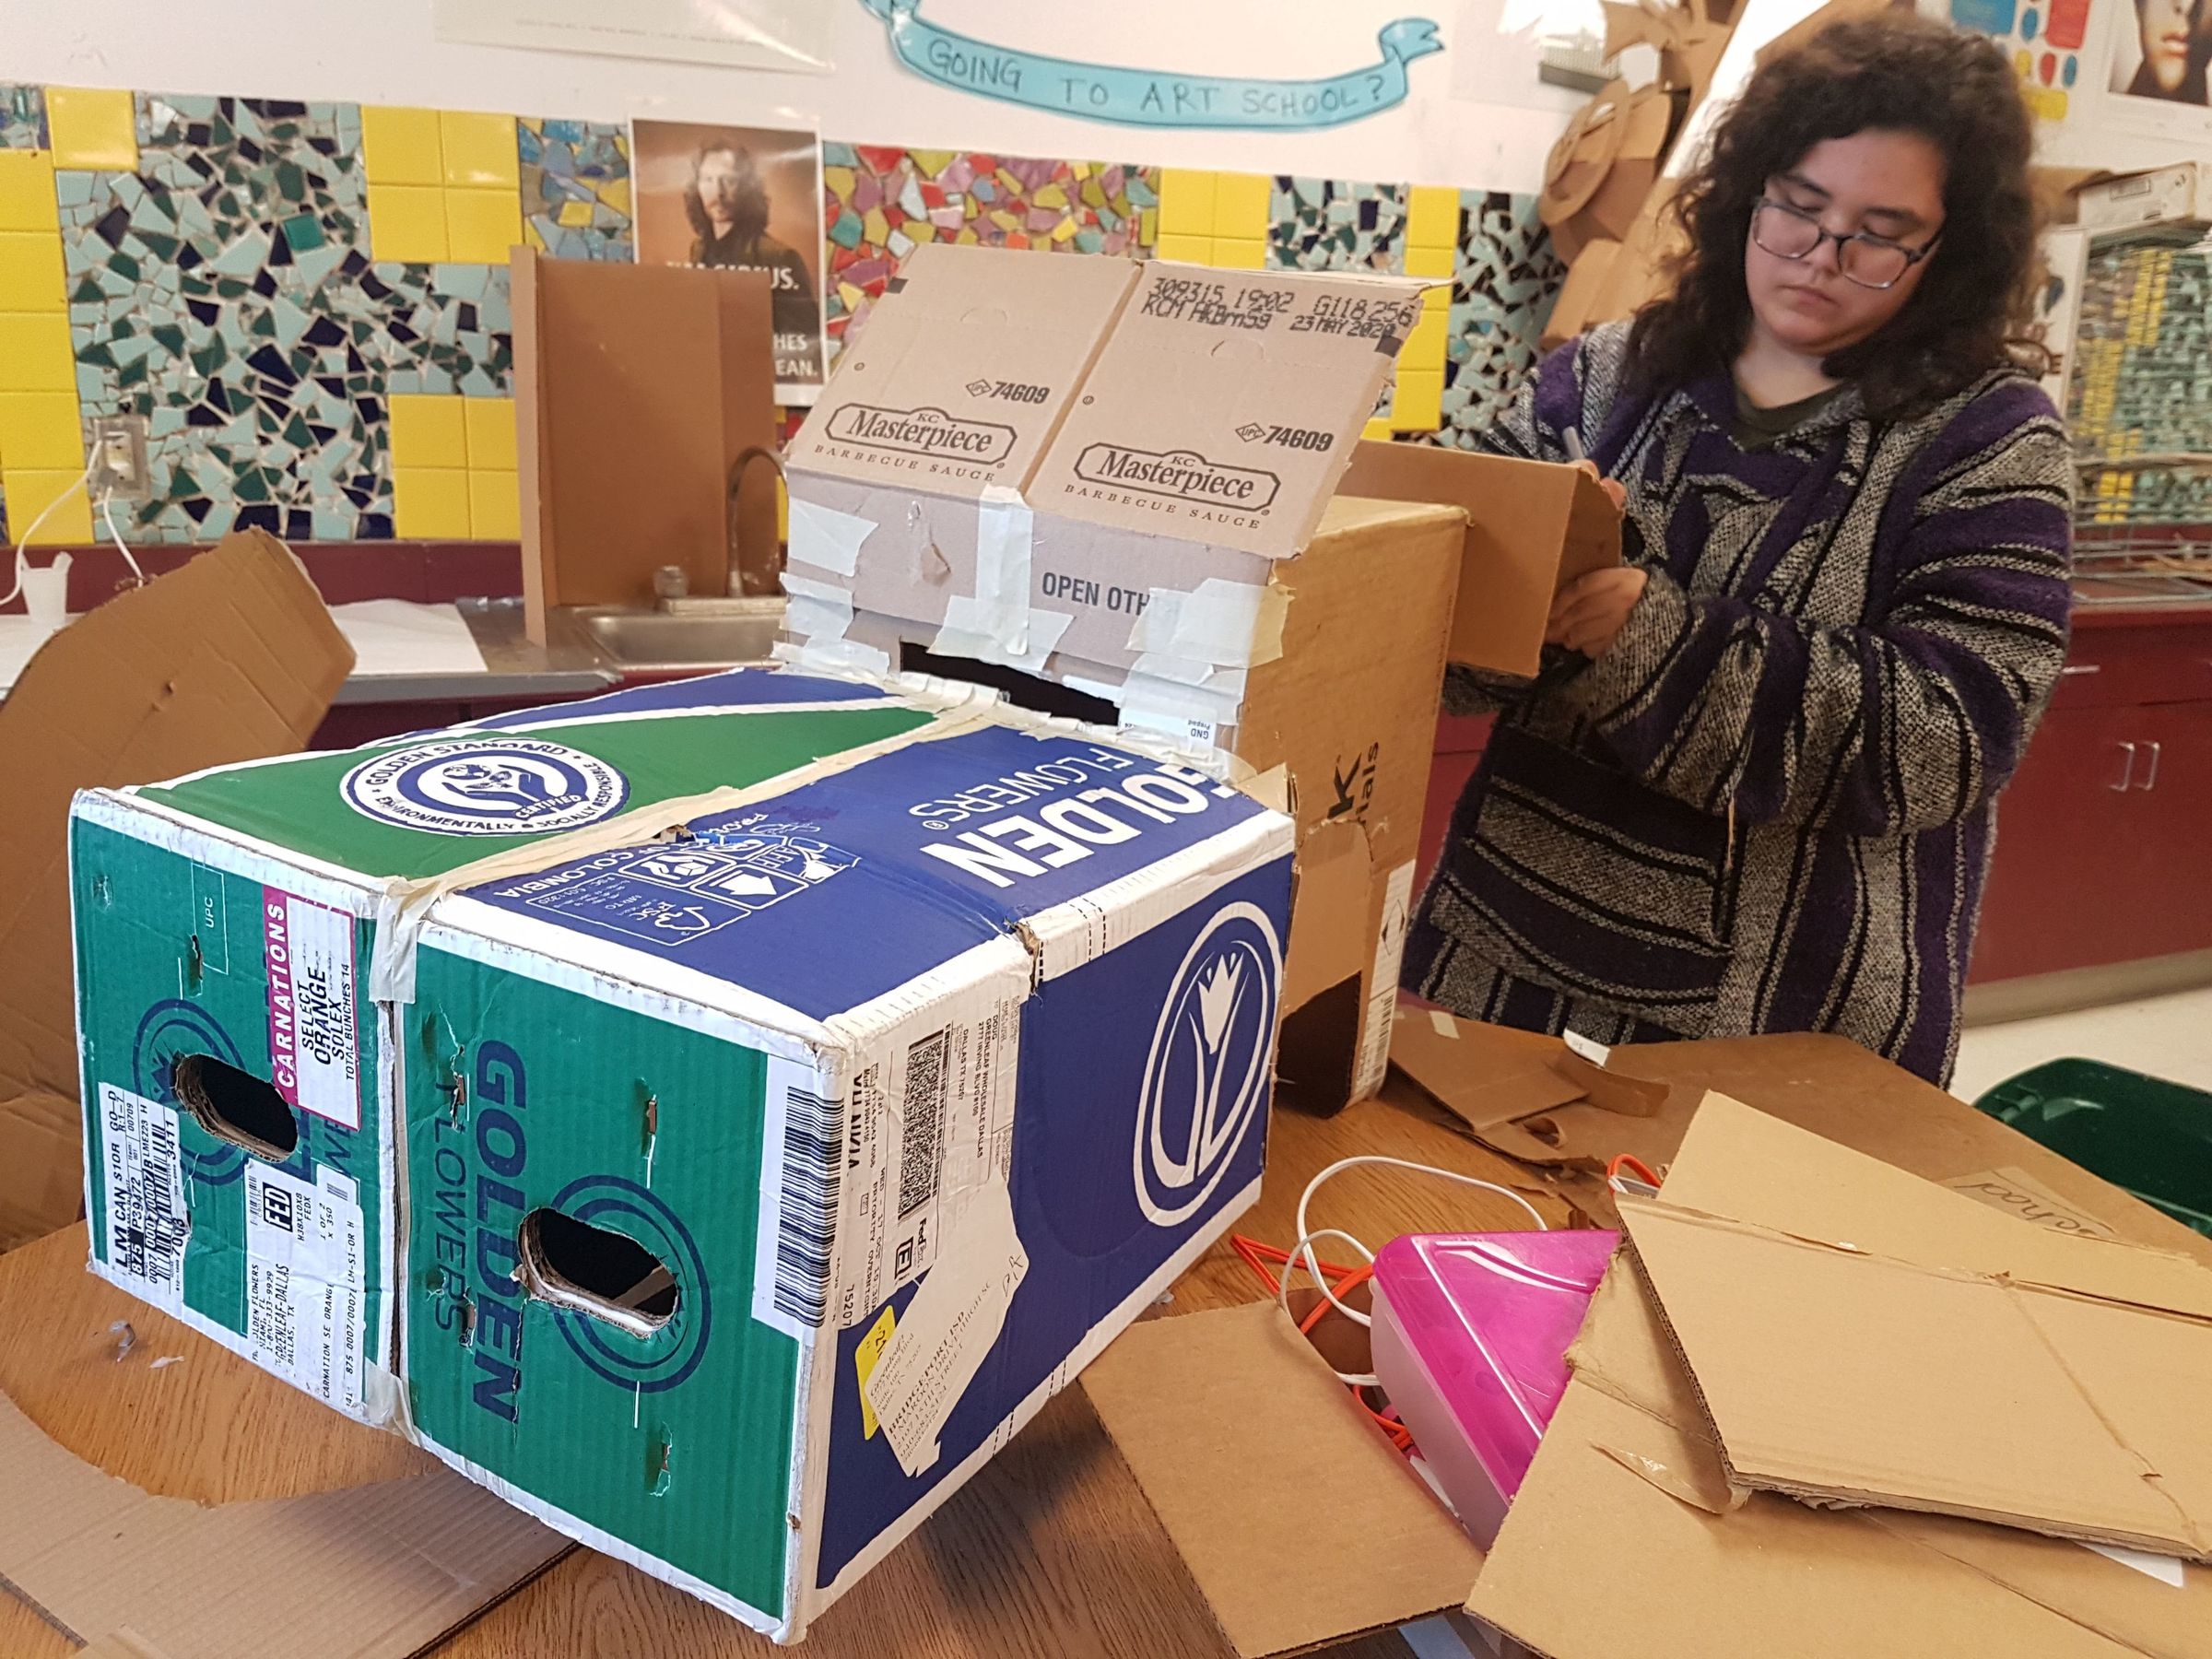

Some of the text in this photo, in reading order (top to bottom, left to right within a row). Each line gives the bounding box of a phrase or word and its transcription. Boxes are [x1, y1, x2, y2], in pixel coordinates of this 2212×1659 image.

[927, 38, 1022, 91] GOING
[1059, 77, 1108, 104] TO
[1139, 82, 1219, 115] ART
[989, 381, 1050, 404] 74609
[846, 410, 994, 453] Masterpiece
[917, 413, 940, 424] KC
[1263, 425, 1335, 452] 74609
[815, 444, 995, 481] BARBECUE SAUCE
[1096, 451, 1254, 500] Masterpiece
[1171, 455, 1196, 467] KC
[1064, 484, 1260, 530] BARBECUE SAUCE
[1041, 571, 1150, 617] OPEN OTH
[1191, 728, 1208, 739] GND
[365, 742, 569, 785] GOLDEN STANDARD
[374, 795, 514, 830] ENVIRONMENTALLY
[536, 805, 602, 829] SOCIALLY
[515, 794, 582, 819] CERTIFIED
[495, 851, 635, 898] COLOMBIA
[206, 897, 215, 928] UPC
[266, 902, 295, 1088] CARNATIONS
[298, 980, 315, 1050] SELECT
[308, 967, 331, 1065] ORANGE
[331, 999, 345, 1062] SOLEX
[341, 964, 355, 1081] TOTAL BUNCHES 14
[960, 1029, 969, 1063] DALLAS
[960, 1065, 967, 1076] TX
[977, 1018, 992, 1159] GREENLEAF WHOLESALE DALLAS
[126, 1102, 135, 1132] 00709
[140, 1104, 147, 1113] H
[141, 1120, 149, 1157] LMEZ23
[166, 1121, 176, 1159] 3411
[144, 1159, 153, 1170] B
[114, 1187, 126, 1221] CAN
[131, 1177, 143, 1229] P39472
[265, 1188, 290, 1229] FED
[296, 1193, 304, 1241] H38X10X8
[303, 1195, 312, 1221] FEDX
[869, 1182, 877, 1242] PRIORITY
[877, 1214, 883, 1229] 17
[320, 1215, 325, 1229] OF
[473, 1040, 526, 1424] GOLDEN
[114, 1225, 127, 1267] LM
[131, 1243, 143, 1274] 875
[259, 1298, 265, 1309] FL
[288, 1305, 294, 1317] TX
[842, 1284, 854, 1326] 75207
[324, 1324, 331, 1338] SE
[888, 1336, 948, 1435] BRIDGEPORT
[948, 1309, 965, 1336] ISD
[897, 1371, 935, 1433] MAROON
[934, 1331, 959, 1373] DRIVE
